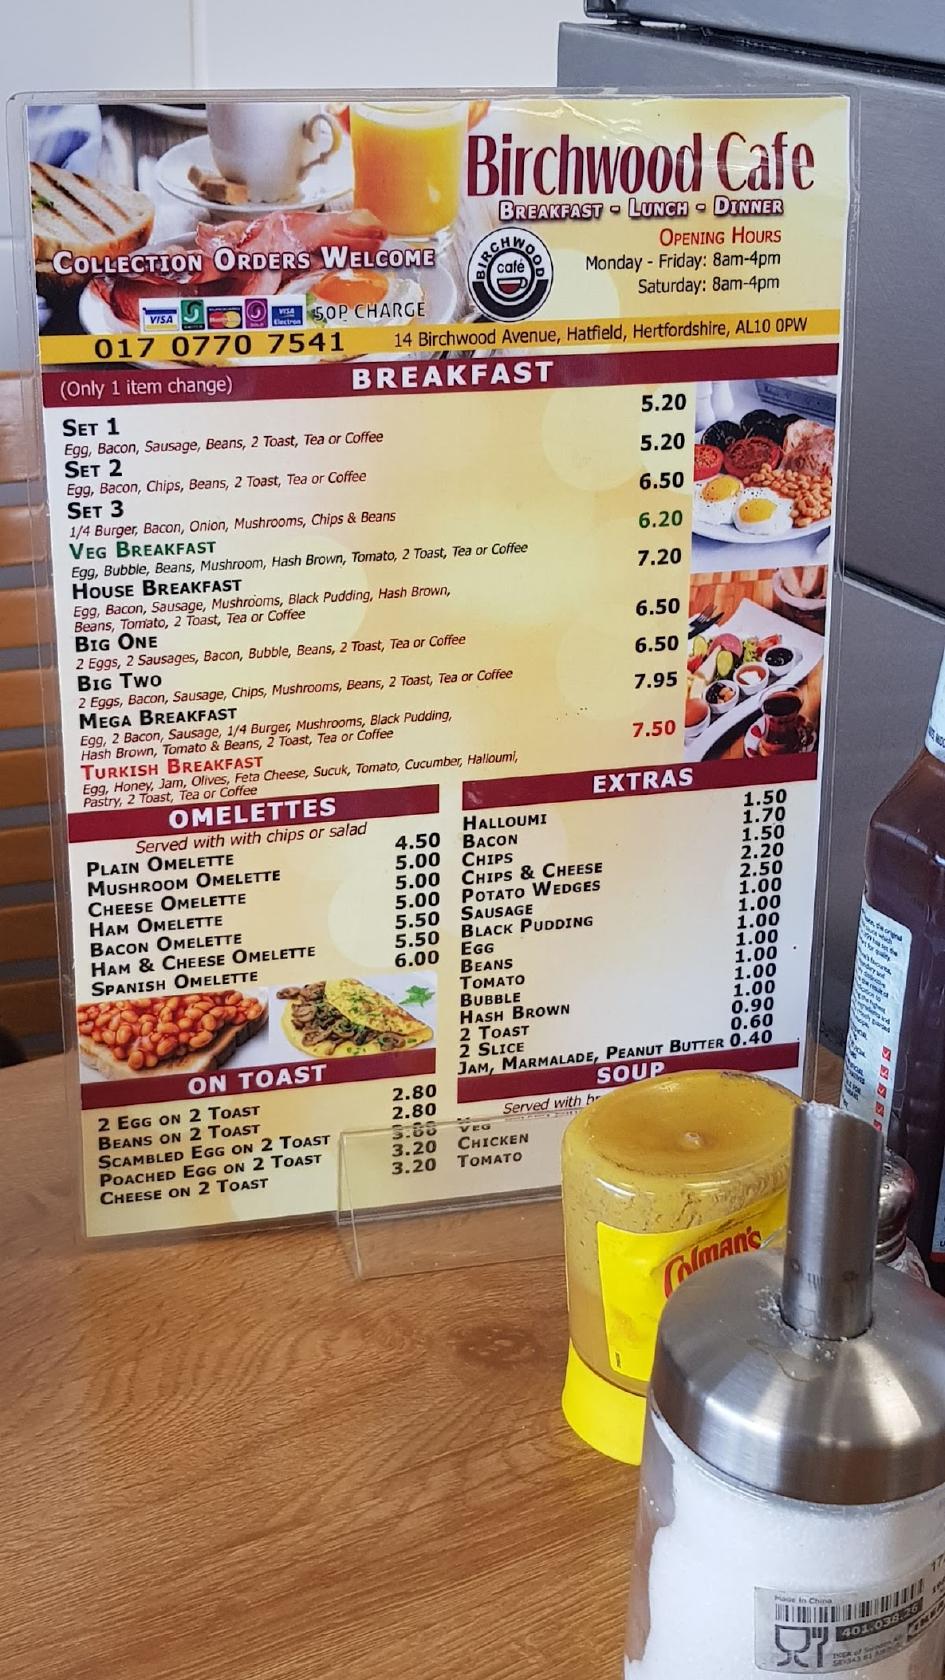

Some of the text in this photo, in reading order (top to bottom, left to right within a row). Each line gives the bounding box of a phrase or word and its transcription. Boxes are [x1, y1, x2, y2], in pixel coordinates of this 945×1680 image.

[467, 131, 815, 197] Birchwood Cafe
[476, 236, 546, 281] BIRCHWOOD
[497, 258, 525, 274] café
[586, 254, 642, 272] Monday
[659, 252, 707, 270] Friday:
[713, 251, 781, 269] 8am-4pm
[638, 276, 779, 295] Saturday: 8am-4pm
[150, 315, 173, 324] VISA
[313, 301, 427, 321] 50P CHARGE
[394, 317, 808, 347] 14 Birchwood Avenue, Hatfield, Hertfordshire, AL10 0PW
[95, 332, 345, 359] 017 0770 7541
[352, 361, 553, 389] BREAKFAST
[60, 375, 231, 400] (Only 1 item change)
[642, 393, 686, 412] 5.20
[64, 431, 383, 458] Egg, Bacon, Sausage, Beans, 2 Toast, Tea or Coffee
[640, 432, 685, 451] 5.20
[639, 471, 684, 490] 6.50
[638, 510, 682, 528] 6.20
[638, 547, 681, 566] 7.20
[636, 598, 680, 616] 6.50
[635, 635, 678, 653] 6.50
[634, 671, 677, 689] 7.95
[632, 719, 675, 737] 7.50
[593, 768, 692, 793] EXTRAS
[744, 789, 786, 806] 1.50
[169, 797, 335, 828] OMELETTES
[743, 807, 785, 824] 1.70
[135, 824, 367, 854] Served with with chips or salad
[395, 832, 440, 850] 4.50
[742, 825, 784, 841] 1.50
[740, 843, 783, 859] 2.20
[395, 852, 440, 870] 5.00
[395, 872, 440, 889] 5.00
[395, 891, 439, 909] 5.00
[395, 911, 439, 929] 5.50
[395, 931, 439, 948] 5.50
[395, 950, 439, 967] 6.00
[188, 1064, 326, 1094] ON TOAST
[597, 1061, 666, 1085] SOUP
[392, 1084, 436, 1101] 2.80
[503, 1099, 549, 1114] Served
[554, 1097, 584, 1111] with
